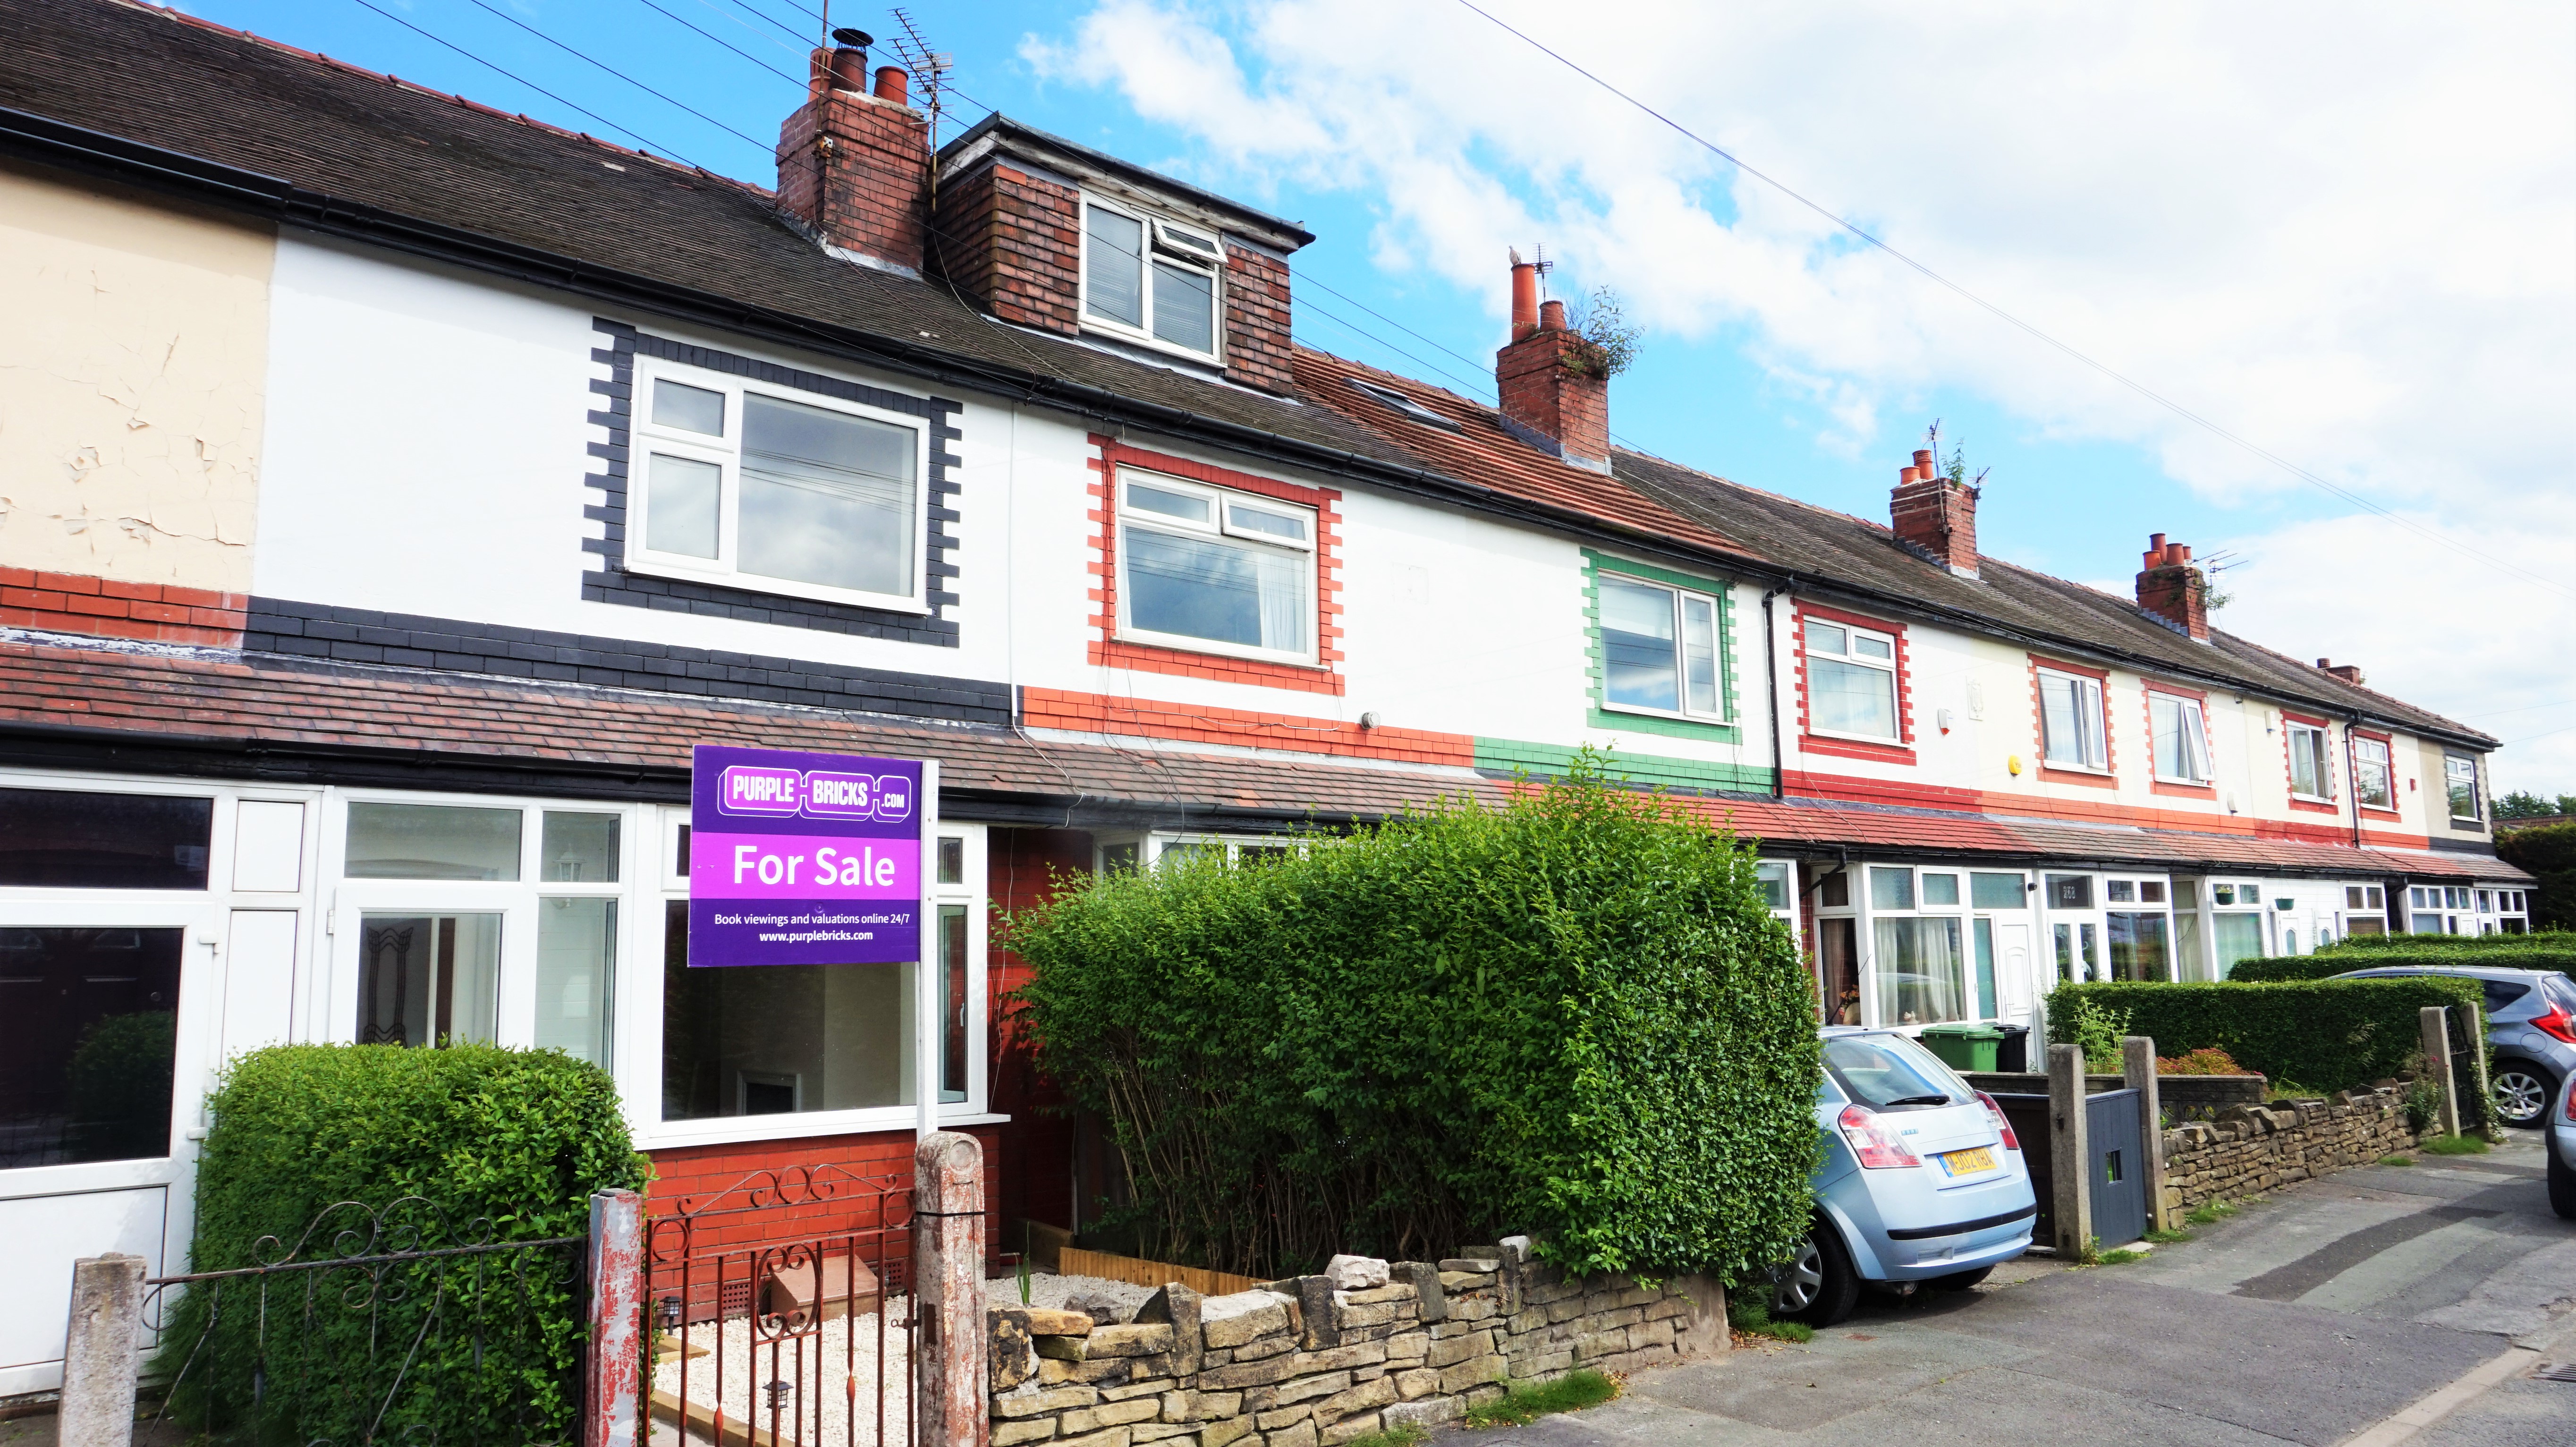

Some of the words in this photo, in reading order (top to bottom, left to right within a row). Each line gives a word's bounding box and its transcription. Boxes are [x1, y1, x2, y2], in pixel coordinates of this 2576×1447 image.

[733, 775, 794, 802] PURPLE
[813, 779, 868, 807] BRICKS
[881, 793, 905, 808] .COM
[734, 845, 805, 885] For
[814, 846, 895, 886] Sale
[714, 913, 742, 925] Book
[744, 913, 788, 927] viewings
[790, 913, 810, 924] and
[811, 913, 860, 924] valuations
[861, 913, 889, 924] online
[890, 913, 910, 925] 24/7
[759, 929, 873, 944] www.purplebricks.com
[1945, 1152, 1977, 1172] MJ02
